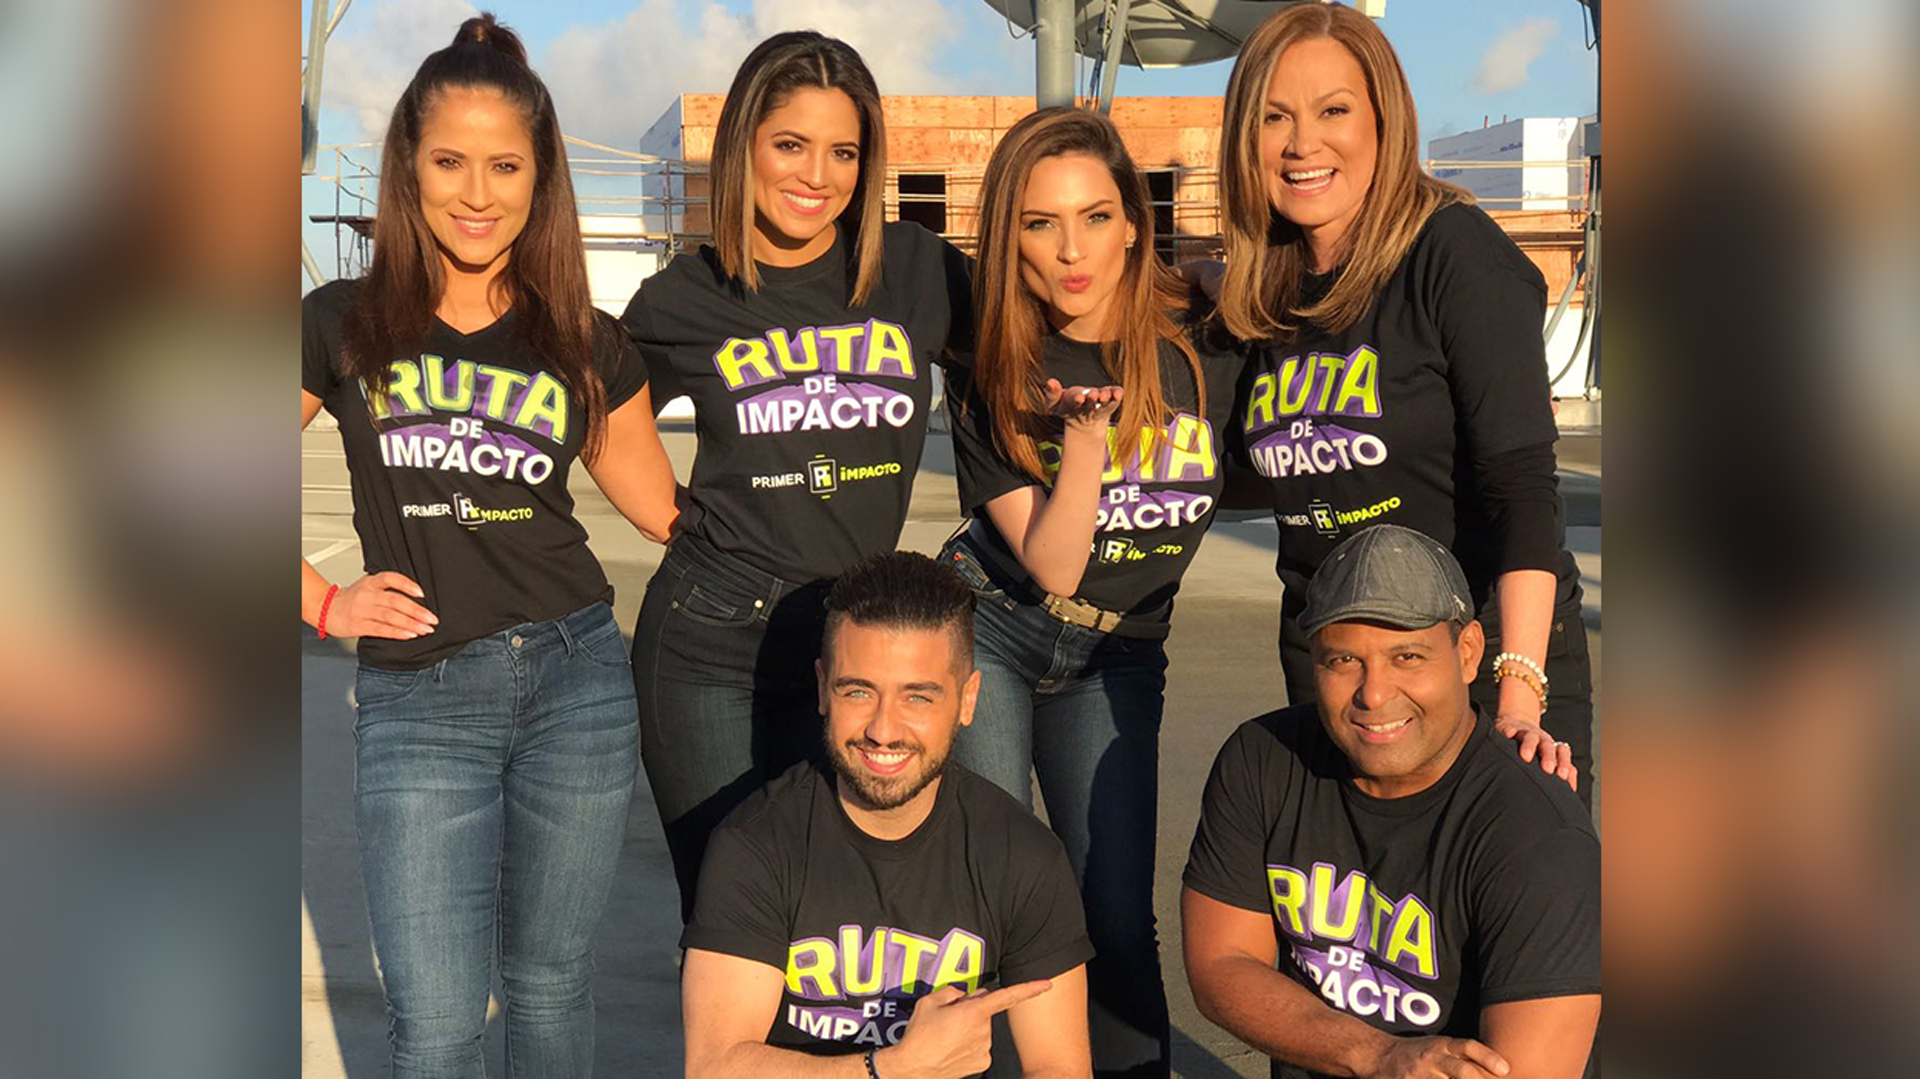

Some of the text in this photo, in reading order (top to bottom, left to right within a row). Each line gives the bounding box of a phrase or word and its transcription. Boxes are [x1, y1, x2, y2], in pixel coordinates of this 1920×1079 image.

[714, 318, 917, 391] RUTA
[359, 354, 568, 445] RUTA
[804, 376, 838, 394] DE
[1245, 345, 1382, 433] RUTA
[450, 417, 484, 440] DE
[736, 394, 914, 434] IMPACTO
[1290, 419, 1314, 439] DE
[379, 433, 554, 485] IMPACTO
[1249, 434, 1388, 478] IMPACTO
[752, 473, 805, 488] PRIMER
[1109, 485, 1141, 505] DE
[402, 503, 453, 518] PRIMER
[477, 507, 534, 521] MPACTO
[1096, 495, 1213, 531] PACTO
[1276, 513, 1312, 526] IMER
[1266, 862, 1440, 980] RUTA
[784, 925, 985, 1001] RUTA
[1328, 946, 1366, 972] DE
[787, 1004, 908, 1045] IMPAC
[862, 1001, 897, 1019] DE
